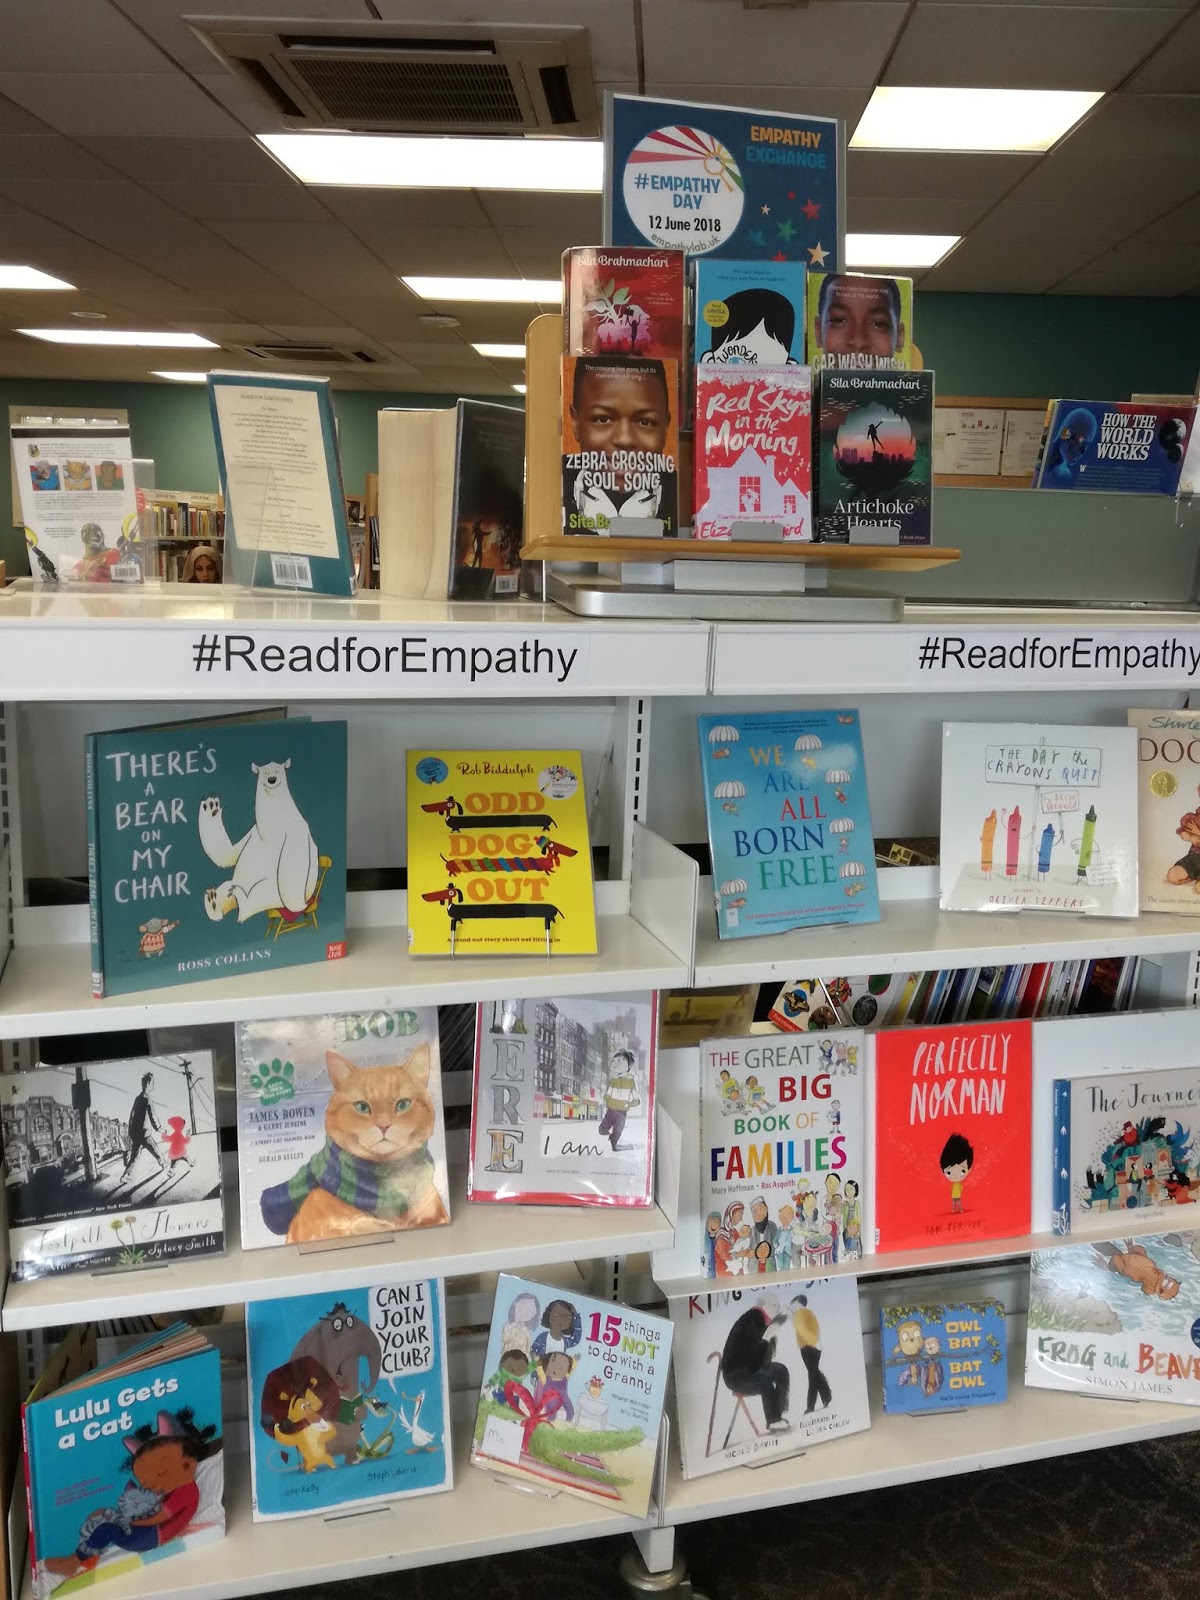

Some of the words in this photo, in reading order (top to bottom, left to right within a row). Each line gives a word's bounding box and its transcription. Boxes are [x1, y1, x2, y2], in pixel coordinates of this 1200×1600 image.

[751, 125, 821, 148] EMPATHY
[746, 147, 826, 168] EXCHANGE
[634, 173, 721, 194] #EMPATHY
[673, 194, 702, 209] DAY
[649, 215, 662, 229] 12
[665, 216, 691, 230] June
[693, 217, 721, 232] 2018
[598, 255, 669, 268] Brahmachari
[838, 352, 873, 370] WASH
[830, 378, 850, 389] Sita
[850, 377, 921, 390] Brahmachari
[706, 384, 753, 419] Red
[757, 386, 801, 422] Sky
[734, 414, 750, 431] in
[755, 411, 779, 432] the
[1101, 412, 1131, 428] HOW
[1132, 414, 1157, 429] THE
[705, 420, 798, 457] Morning
[1100, 426, 1154, 446] WORLD
[566, 450, 608, 470] ZEBRA
[611, 450, 675, 474] CROSSING
[1096, 442, 1150, 461] WORKS
[584, 471, 619, 491] SOUL
[624, 472, 661, 492] SONG
[833, 498, 914, 515] Artichoke
[569, 513, 594, 529] Sita
[192, 634, 578, 682] #ReadforEmpathy
[919, 637, 1200, 676] #ReadforEmpathy
[1148, 716, 1200, 740] Shirle
[105, 743, 217, 782] THERE'S
[750, 745, 785, 767] WE
[1000, 748, 1021, 760] THE
[1032, 748, 1060, 765] DAY
[1072, 750, 1088, 766] the
[456, 762, 482, 775] Rob
[482, 762, 536, 778] Biddulph
[764, 770, 810, 793] ARE
[987, 760, 1052, 780] CRAYONS
[1062, 766, 1098, 785] QUIT
[144, 782, 155, 796] A
[465, 791, 545, 814] ODD
[780, 795, 827, 821] ALL
[115, 798, 188, 831] BEAR
[142, 829, 161, 843] ON
[448, 833, 533, 856] DOG
[733, 823, 825, 857] BORN
[132, 844, 172, 871] MY
[759, 854, 837, 890] FREE
[114, 871, 191, 903] CHAIR
[466, 877, 550, 902] OUT
[989, 895, 1029, 905] OLIVER
[1035, 896, 1084, 907] JEFFERS
[177, 960, 211, 972] ROSS
[215, 949, 272, 967] COLLINS
[342, 1009, 419, 1042] BOB
[709, 1051, 740, 1067] THE
[744, 1045, 814, 1069] GREAT
[912, 1033, 1012, 1076] PERFECTLY
[779, 1074, 832, 1102] BIG
[1086, 1085, 1121, 1113] The
[1127, 1083, 1200, 1109] Journe
[910, 1078, 1006, 1125] NORMAN
[249, 1109, 279, 1123] JAMES
[282, 1106, 315, 1120] BOWEN
[734, 1114, 790, 1135] BOOK
[796, 1112, 819, 1129] OF
[263, 1122, 283, 1131] GARRY
[561, 1140, 604, 1157] am
[711, 1136, 847, 1182] FAMILIES
[711, 1186, 727, 1195] Mary
[728, 1184, 755, 1193] Hoffman
[761, 1182, 772, 1190] Ros
[772, 1179, 796, 1190] Asquith
[141, 1209, 210, 1240] Flowers
[148, 1243, 183, 1258] Sydney
[185, 1235, 216, 1251] Smith
[376, 1286, 410, 1307] CAN
[415, 1283, 423, 1301] I
[375, 1305, 425, 1331] JOIN
[586, 1312, 623, 1347] 15
[624, 1320, 661, 1341] things
[945, 1320, 982, 1334] OWL
[378, 1326, 429, 1354] YOUR
[621, 1337, 660, 1360] NOT
[948, 1336, 982, 1349] BAT
[381, 1346, 431, 1374] CLUB?
[588, 1344, 600, 1357] to
[602, 1350, 618, 1363] do
[620, 1355, 644, 1373] with
[647, 1366, 655, 1376] a
[1038, 1336, 1096, 1371] FROG
[1103, 1352, 1129, 1369] and
[949, 1360, 982, 1374] BAT
[603, 1366, 653, 1395] Granny
[950, 1375, 986, 1389] OWL
[1086, 1375, 1128, 1390] SIMON
[1132, 1381, 1173, 1395] JAMES
[55, 1397, 110, 1429] Lulu
[117, 1376, 180, 1408] Gets
[58, 1433, 76, 1450] a
[83, 1411, 133, 1441] Cat
[367, 1470, 390, 1483] Steph
[302, 1483, 320, 1495] Kelly
